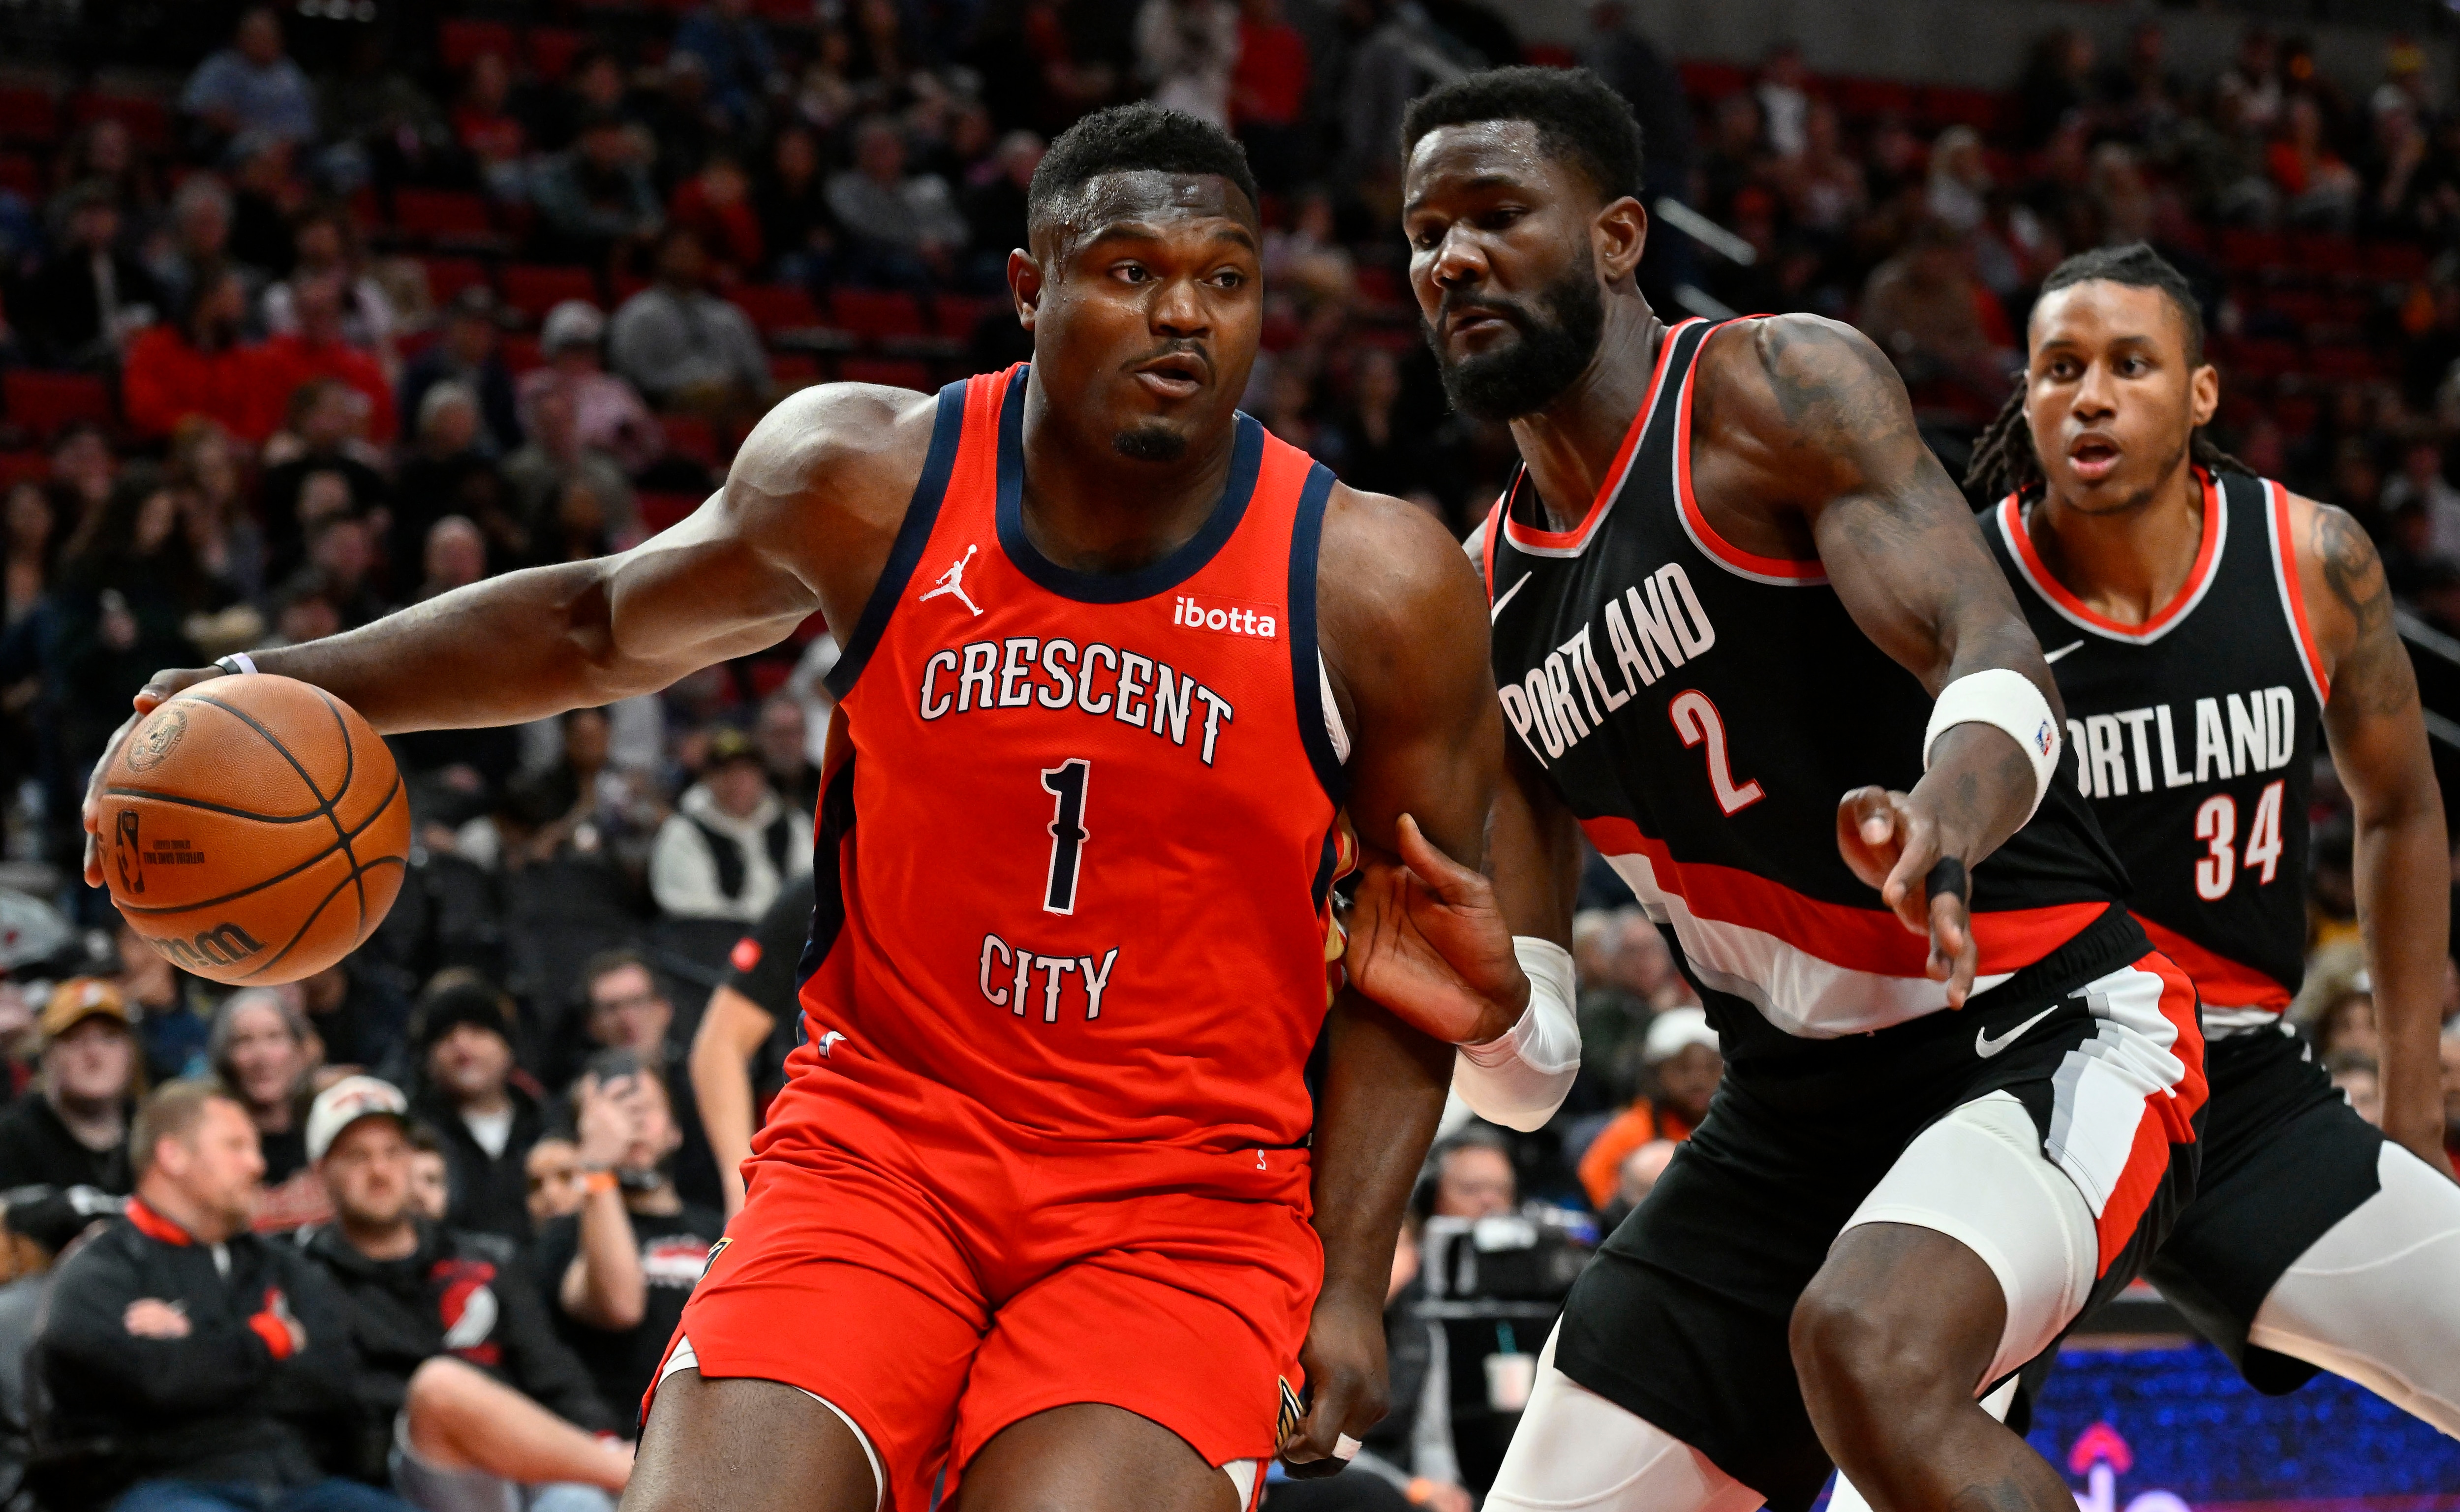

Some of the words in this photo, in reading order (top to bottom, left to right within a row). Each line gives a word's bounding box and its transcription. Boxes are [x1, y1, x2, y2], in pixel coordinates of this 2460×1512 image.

[1173, 597, 1276, 638] ibotta
[1498, 562, 1716, 770] PORTLAND
[920, 637, 1234, 768] CRESCENT
[1668, 689, 1766, 818] 2
[1041, 758, 1090, 916] 1
[2195, 779, 2284, 902] 34
[979, 933, 1119, 1024] CITY
